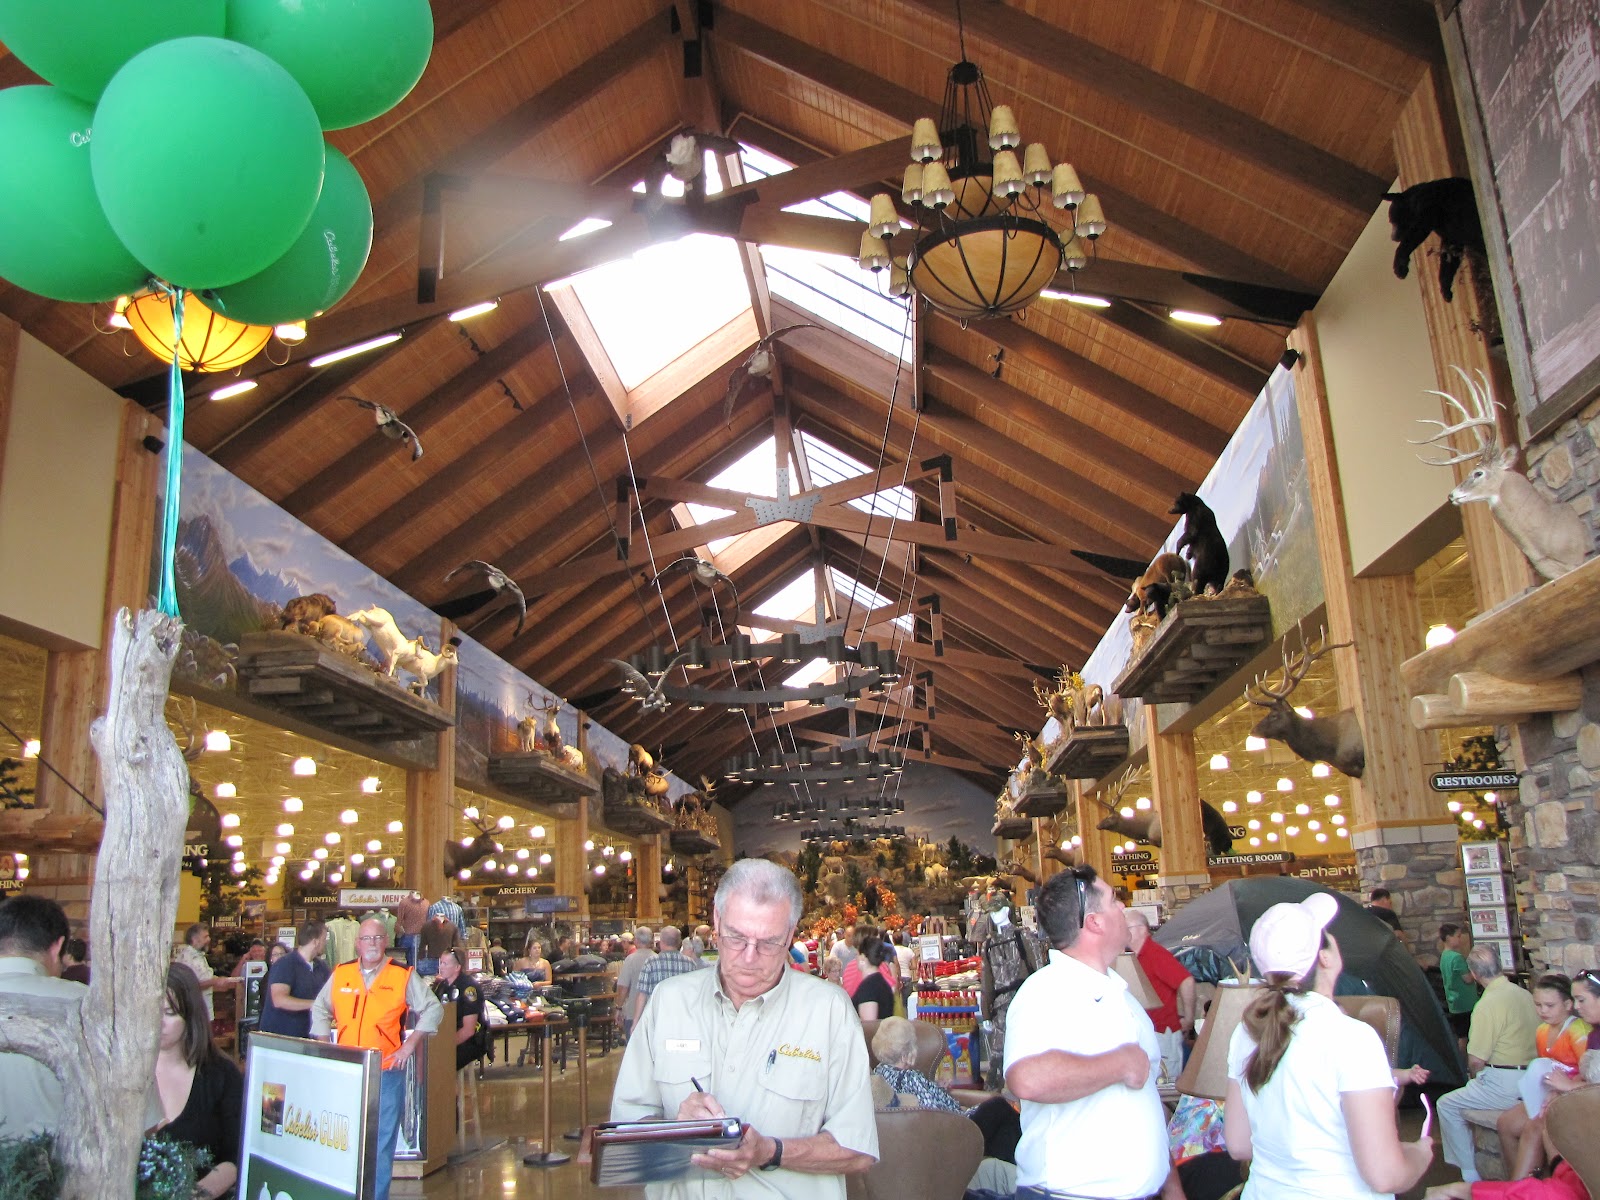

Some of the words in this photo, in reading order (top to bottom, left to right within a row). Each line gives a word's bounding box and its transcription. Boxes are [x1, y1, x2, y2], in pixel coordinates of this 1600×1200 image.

[1436, 775, 1511, 787] RESTROOMS
[1216, 855, 1253, 865] FITTING
[1255, 853, 1283, 862] ROOM
[498, 887, 538, 895] ARCHERY
[777, 1042, 822, 1063] Cabela's
[284, 1102, 319, 1142] Cabela's
[319, 1109, 350, 1152] CLUB
